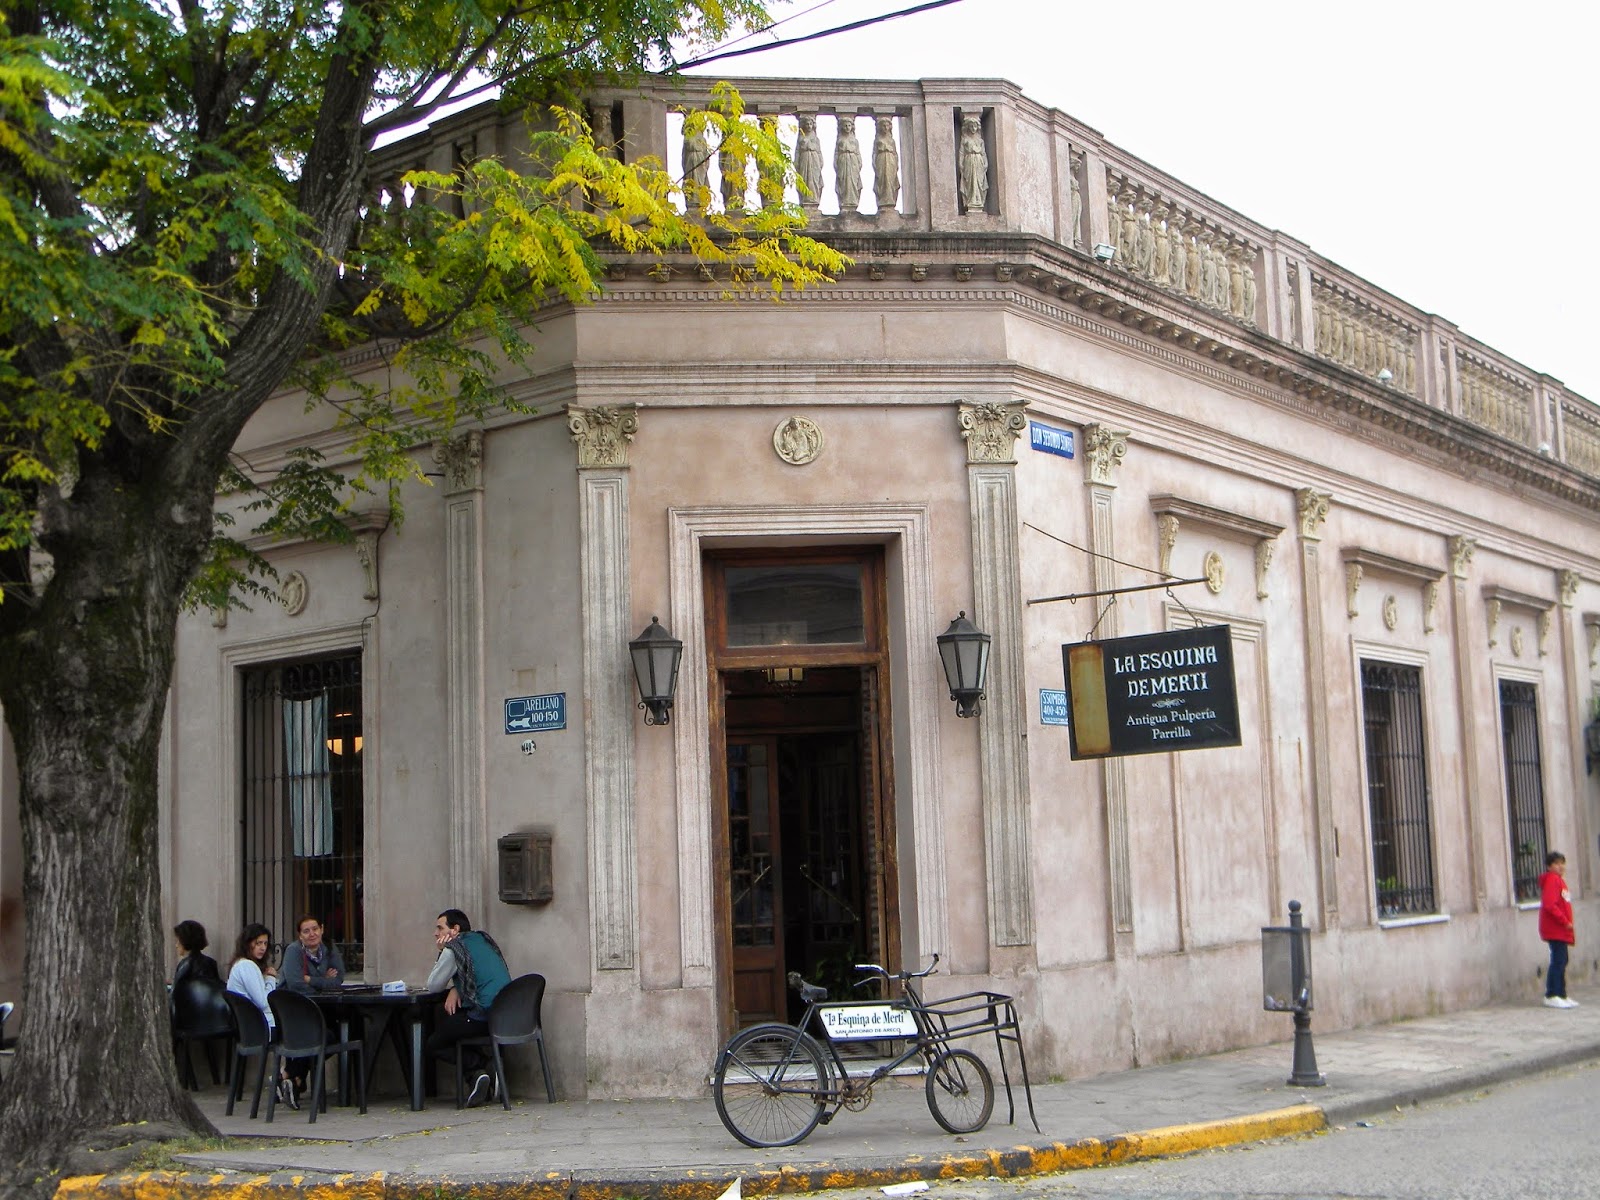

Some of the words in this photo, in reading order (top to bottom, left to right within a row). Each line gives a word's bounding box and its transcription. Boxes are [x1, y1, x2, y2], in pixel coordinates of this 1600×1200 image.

[1113, 655, 1136, 675] LA
[1139, 645, 1218, 671] ESQUINA
[1128, 678, 1149, 698] DE
[1150, 671, 1209, 694] MERTI
[525, 696, 560, 712] ARELLANO
[1126, 713, 1169, 727] Antigua
[1170, 707, 1217, 724] Pulpería
[1152, 725, 1192, 740] Parrilla
[838, 1011, 870, 1028] Esquina
[872, 1012, 882, 1025] de
